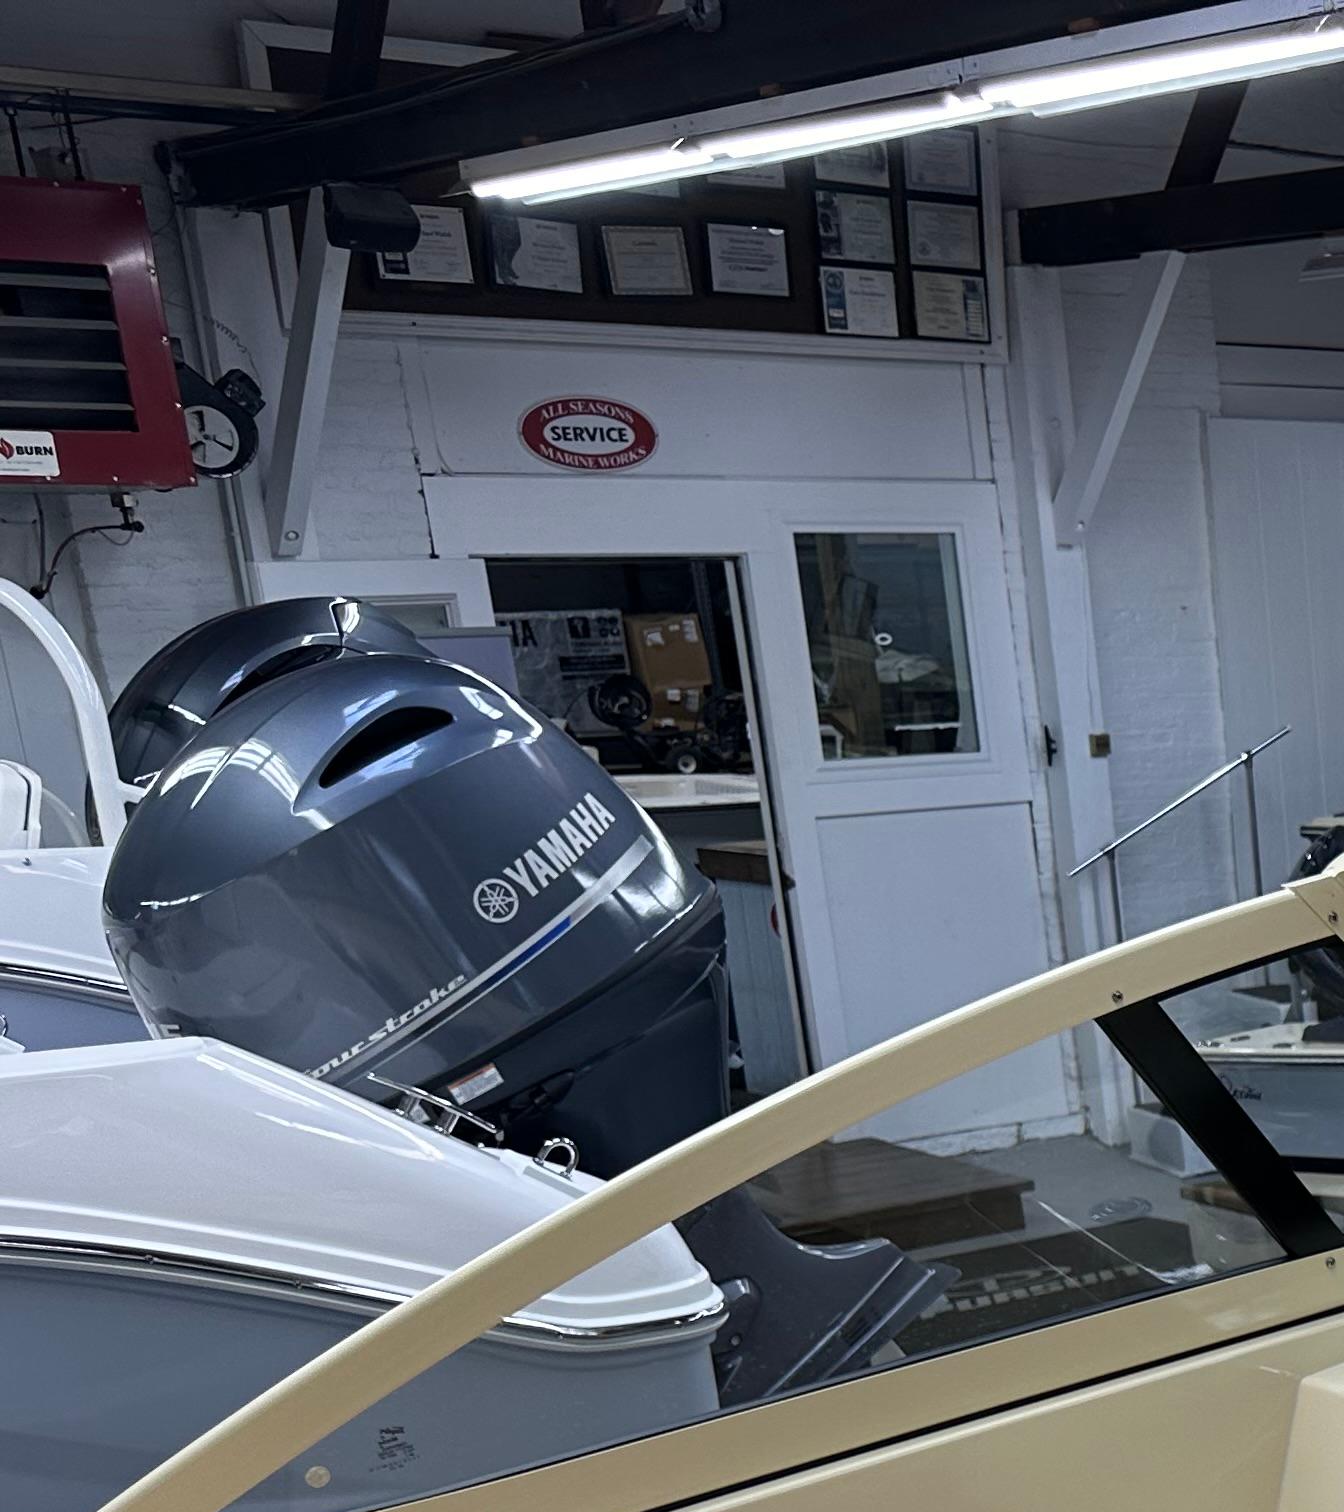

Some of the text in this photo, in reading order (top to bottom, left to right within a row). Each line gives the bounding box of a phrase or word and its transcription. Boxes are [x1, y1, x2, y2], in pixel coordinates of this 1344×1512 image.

[541, 401, 634, 423] ALL SEASONS
[550, 426, 629, 442] SERVICE
[15, 446, 54, 456] BURN
[540, 444, 647, 468] MARINE WORKS
[502, 792, 616, 897] YAMAHA
